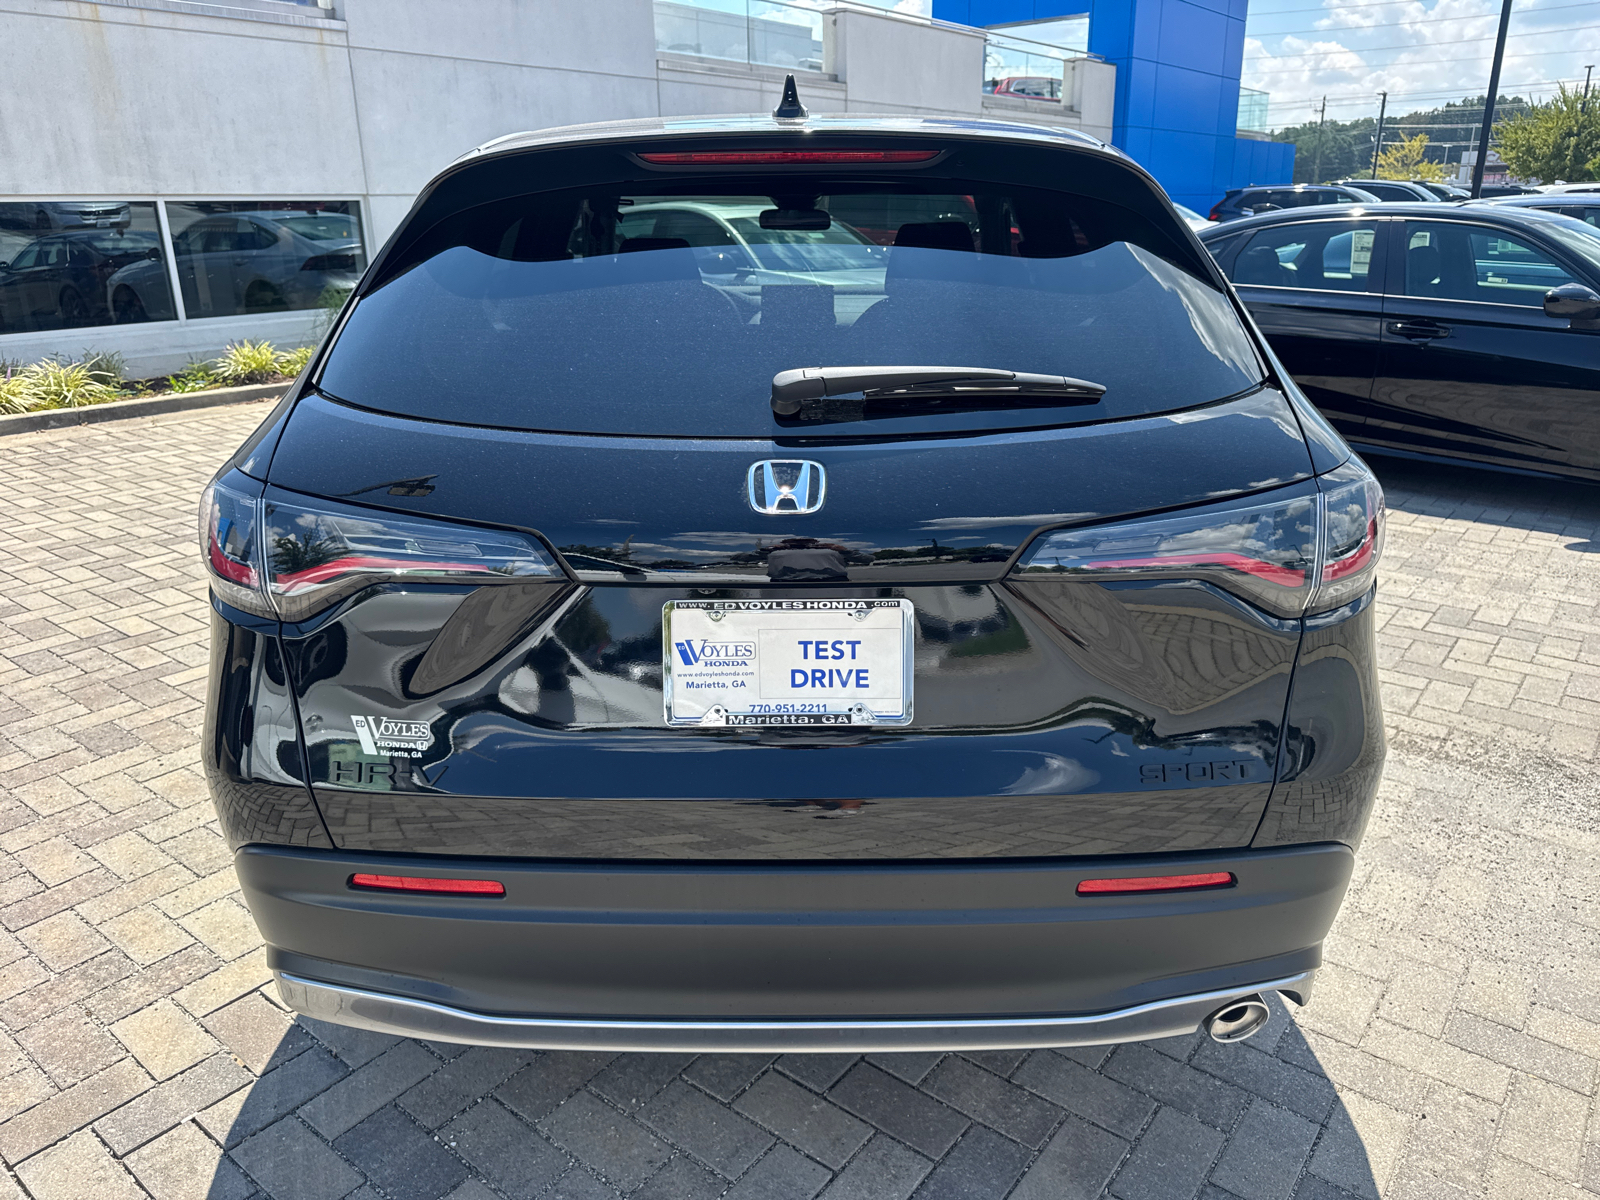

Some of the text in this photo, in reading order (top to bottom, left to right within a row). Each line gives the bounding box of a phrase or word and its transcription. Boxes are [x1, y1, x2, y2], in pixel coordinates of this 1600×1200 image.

[685, 639, 753, 663] VOYLES
[797, 640, 861, 660] TEST
[686, 680, 746, 690] Marietta, GA
[790, 669, 869, 688] DRIVE
[749, 704, 827, 713] 770-951-2211
[367, 716, 428, 739] VOYLES
[728, 714, 849, 725] Marietta, GA
[380, 750, 410, 758] Marietta,
[329, 761, 449, 786] HR-V
[1139, 759, 1256, 784] SPORT
